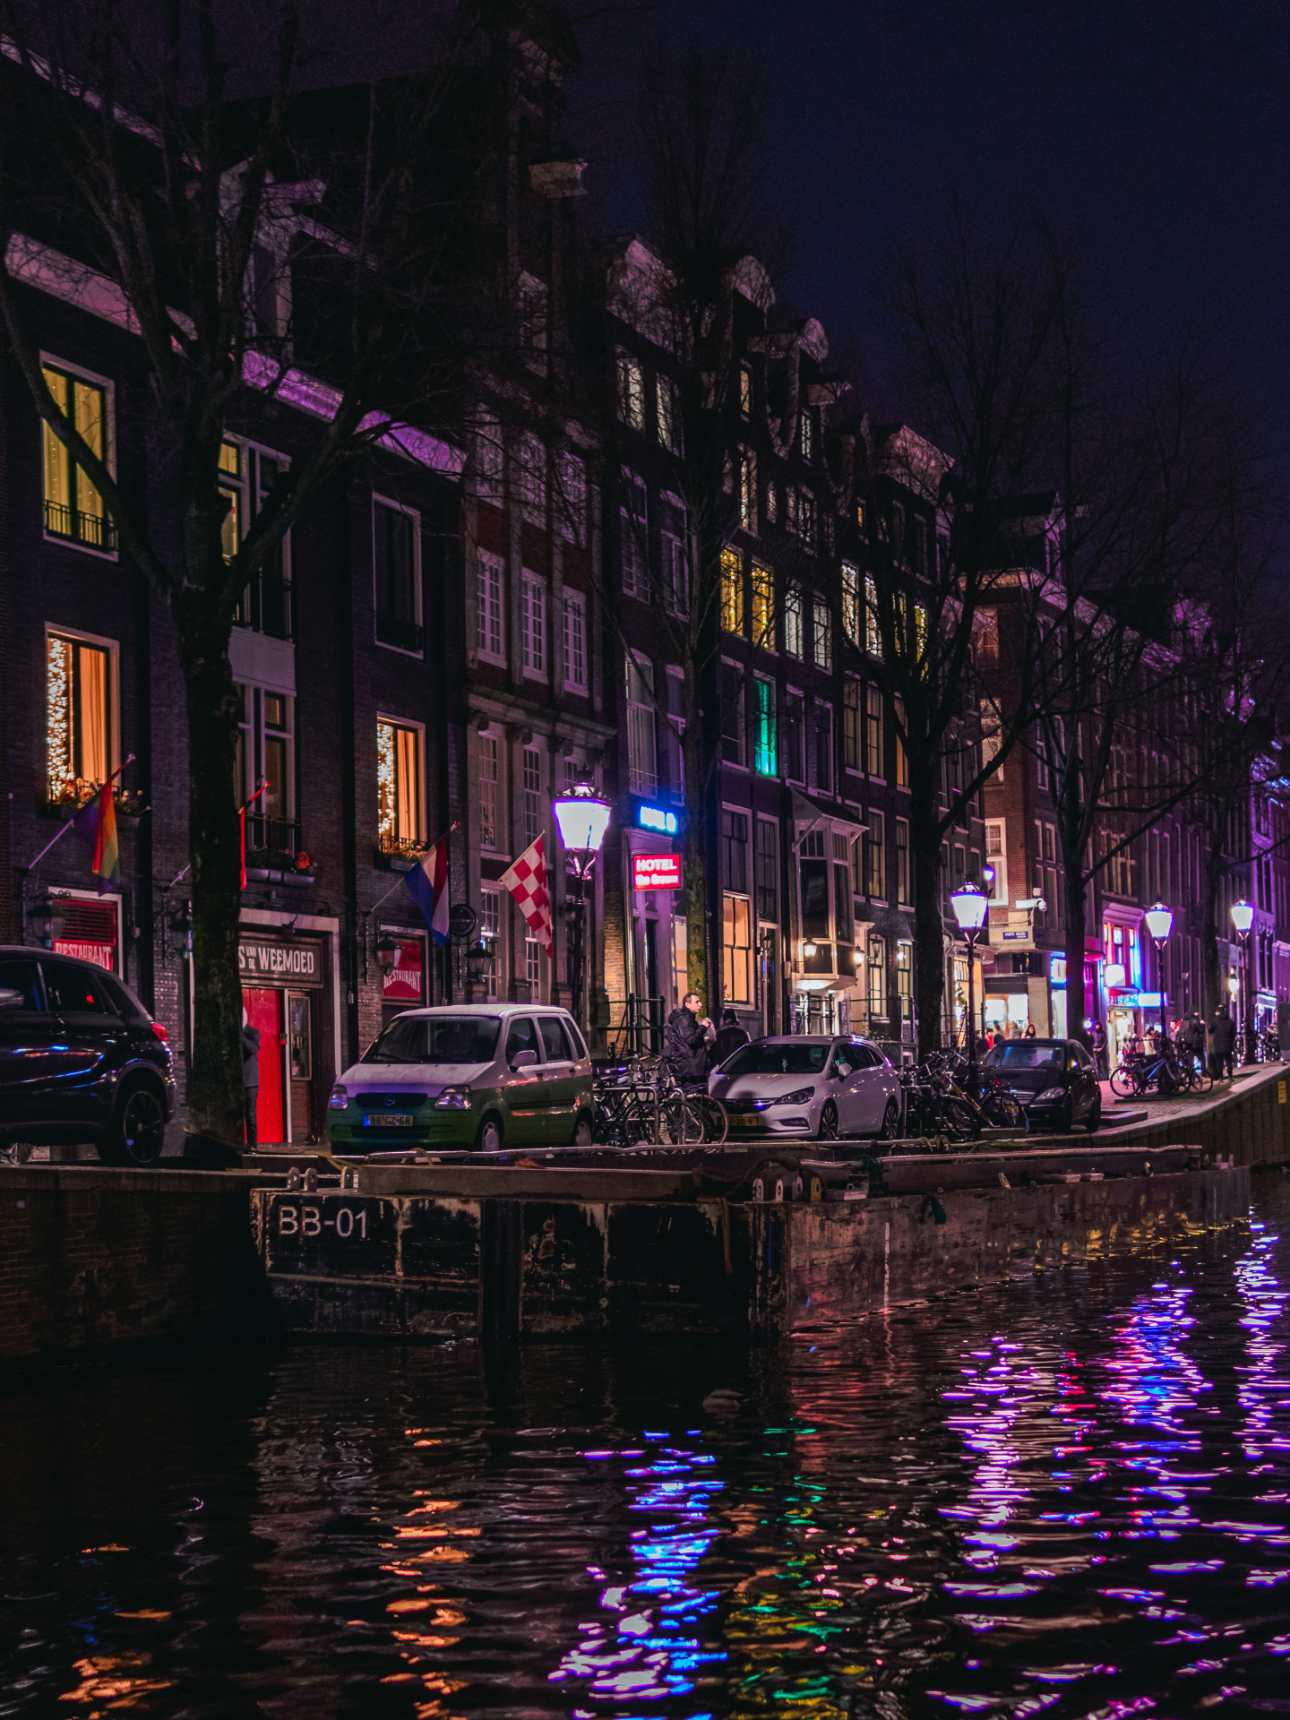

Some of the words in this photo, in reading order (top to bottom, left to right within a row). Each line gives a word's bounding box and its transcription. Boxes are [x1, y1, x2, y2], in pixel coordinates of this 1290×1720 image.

[636, 859, 677, 871] HOTEL
[245, 946, 257, 957] VAN
[248, 958, 256, 969] DE
[258, 947, 315, 973] WEEMOED
[278, 1205, 367, 1239] BB-01
